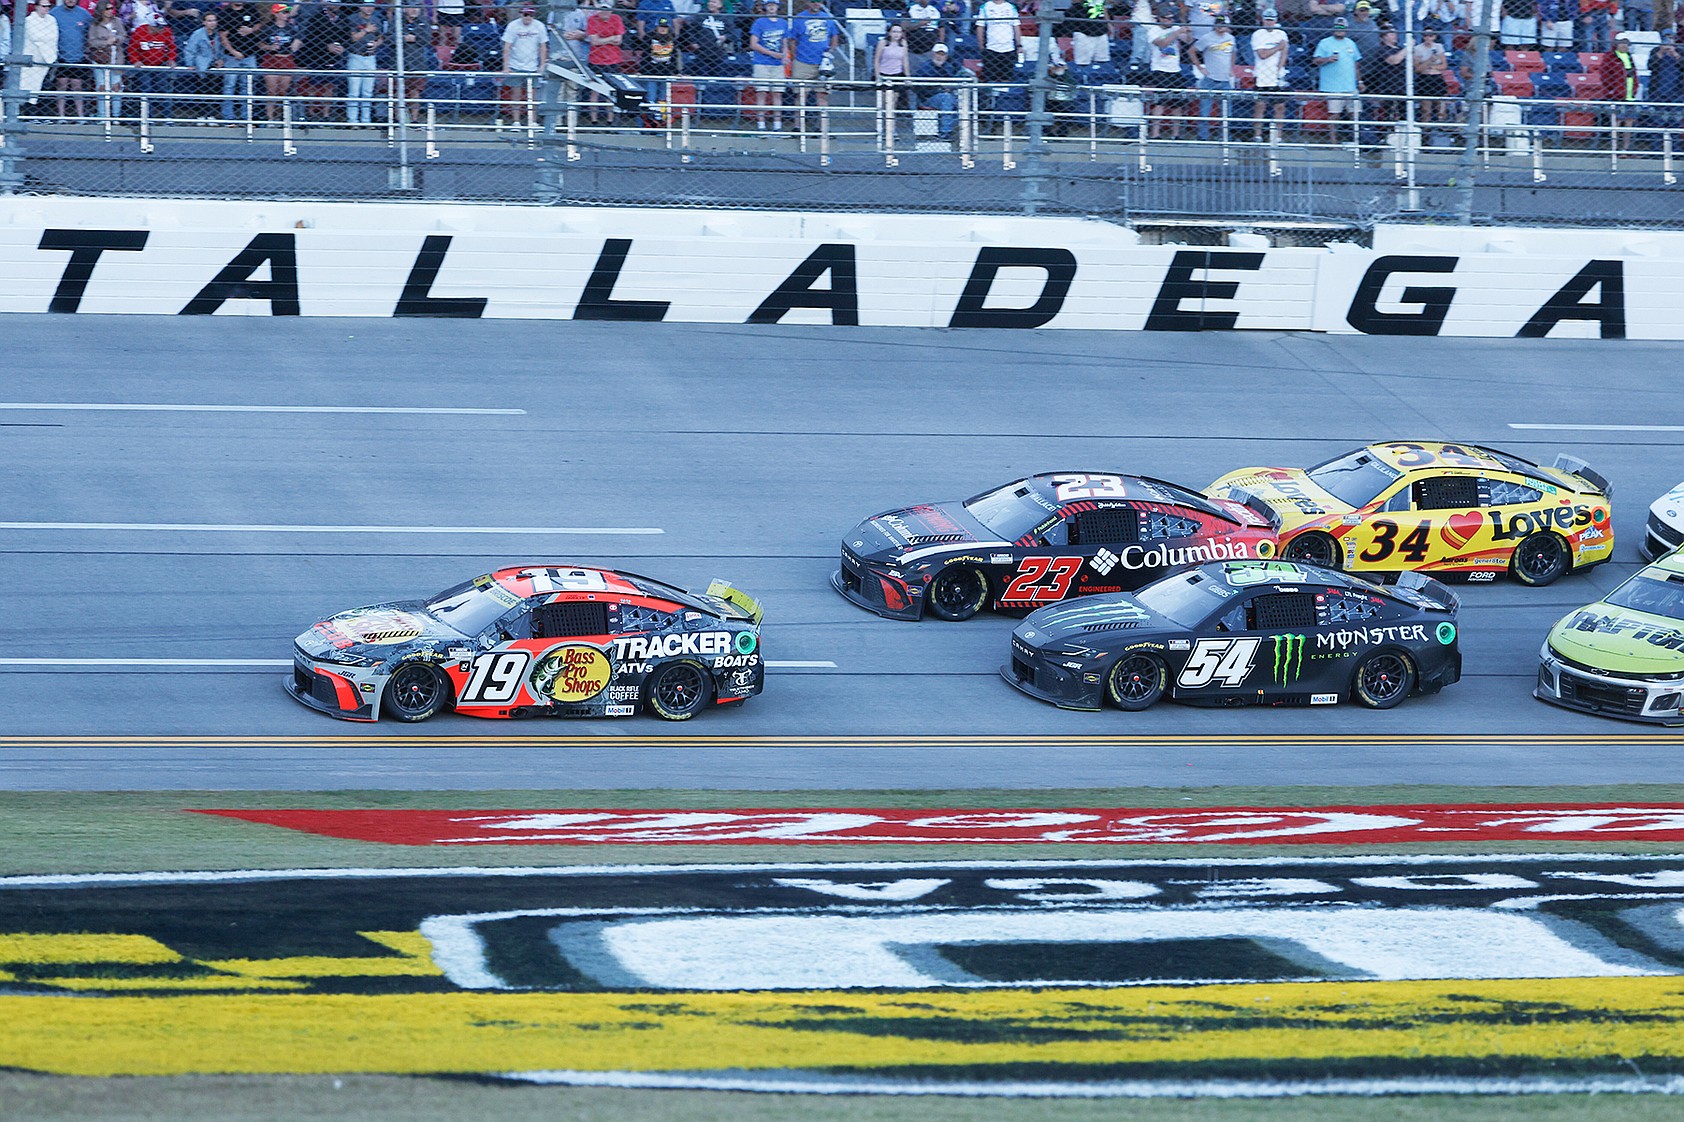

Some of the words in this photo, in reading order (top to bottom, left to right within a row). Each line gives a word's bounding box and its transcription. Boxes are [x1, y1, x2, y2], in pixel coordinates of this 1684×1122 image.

[38, 228, 1627, 340] TALLADEGA
[1360, 519, 1433, 563] 34
[1579, 529, 1605, 543] PEAK
[943, 555, 984, 565] GOODYEAR
[1121, 536, 1248, 570] Columbia
[1001, 556, 1084, 602] 23
[1469, 571, 1496, 579] FORD
[1078, 585, 1121, 593] ENGINEERED
[1316, 624, 1430, 650] MONSTER
[613, 631, 732, 660] TRACKER
[1124, 641, 1165, 652] GOODYEAR
[563, 648, 596, 664] Bass
[714, 654, 759, 668] BOATS
[1310, 651, 1359, 660] ENERGY
[617, 663, 654, 674] ATVs
[1062, 661, 1084, 670] JGR
[1177, 637, 1263, 689] 54
[337, 670, 357, 679] JGR
[462, 652, 529, 702] 19
[562, 663, 588, 678] Pro
[561, 677, 602, 697] Shops
[609, 691, 640, 700] COFFEE
[1312, 695, 1329, 703] Mobil
